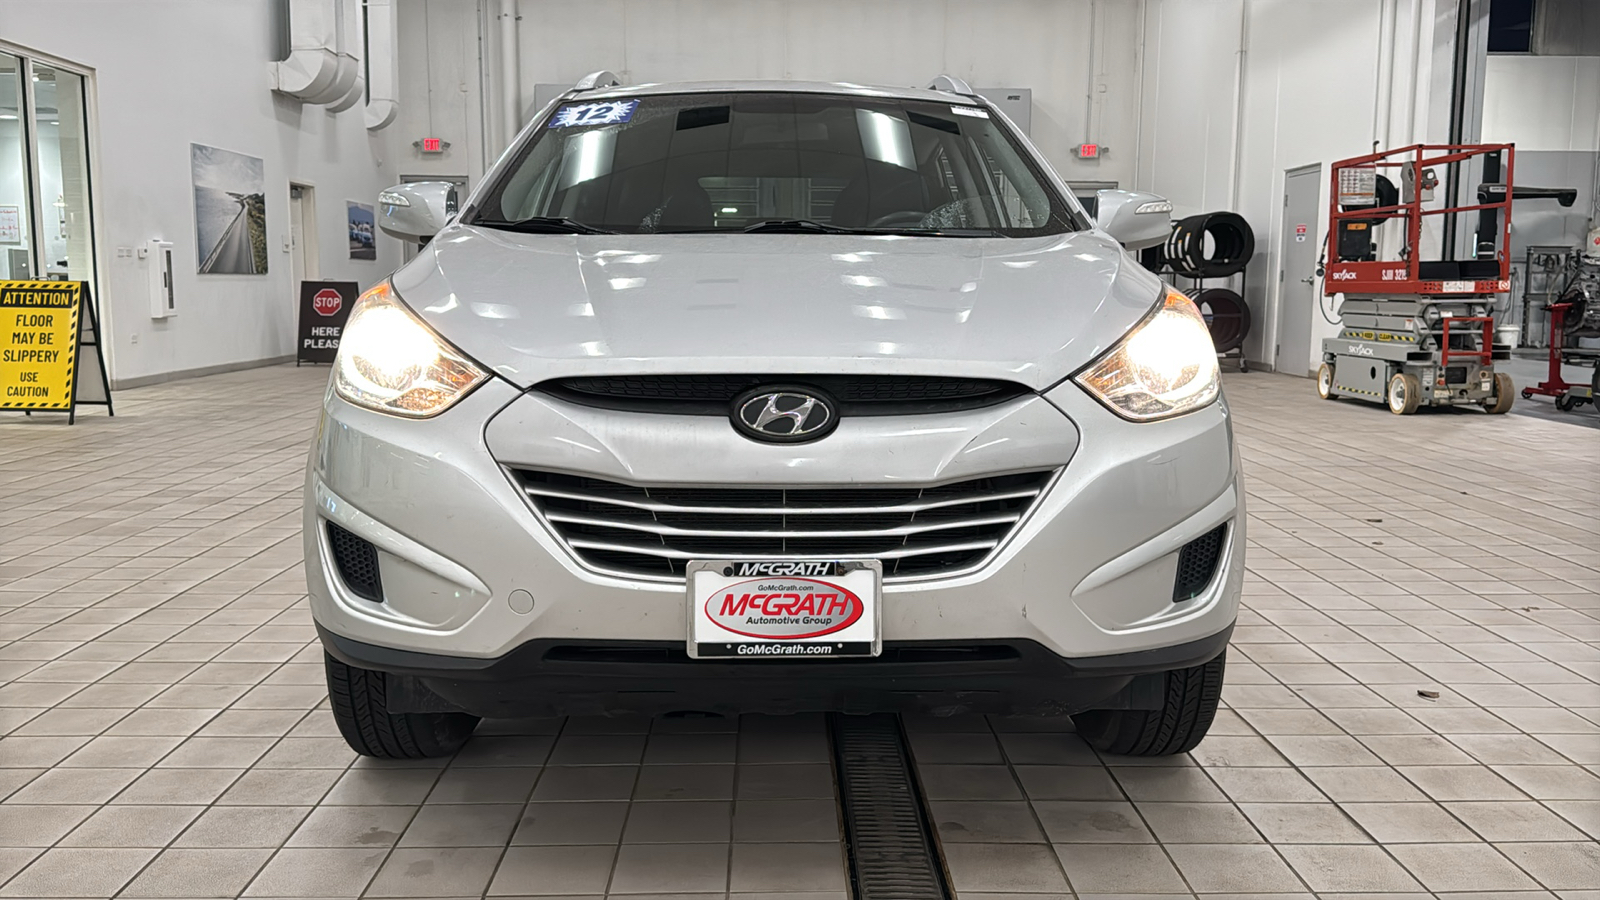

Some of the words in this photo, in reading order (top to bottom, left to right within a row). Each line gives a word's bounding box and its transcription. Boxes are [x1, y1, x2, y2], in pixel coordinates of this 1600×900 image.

[575, 106, 614, 121] 12
[424, 138, 440, 150] EXIT
[1081, 144, 1096, 156] EXIT
[1333, 269, 1357, 280] SKYJACK
[3, 292, 69, 305] ATTENTION
[315, 297, 340, 308] STOP
[16, 315, 53, 327] FLOOR
[312, 327, 340, 336] HERE
[11, 332, 36, 345] MAY
[38, 332, 54, 345] BE
[304, 339, 339, 348] PLEAS
[1349, 344, 1373, 355] SKYJACK
[3, 350, 59, 362] SLIPPERY
[19, 371, 39, 383] USE
[6, 386, 49, 398] CAUTION
[757, 584, 815, 592] GoMcGrath.com
[745, 616, 801, 626] Automotive
[801, 616, 833, 627] Group
[736, 644, 833, 656] GoMcGrath.com
